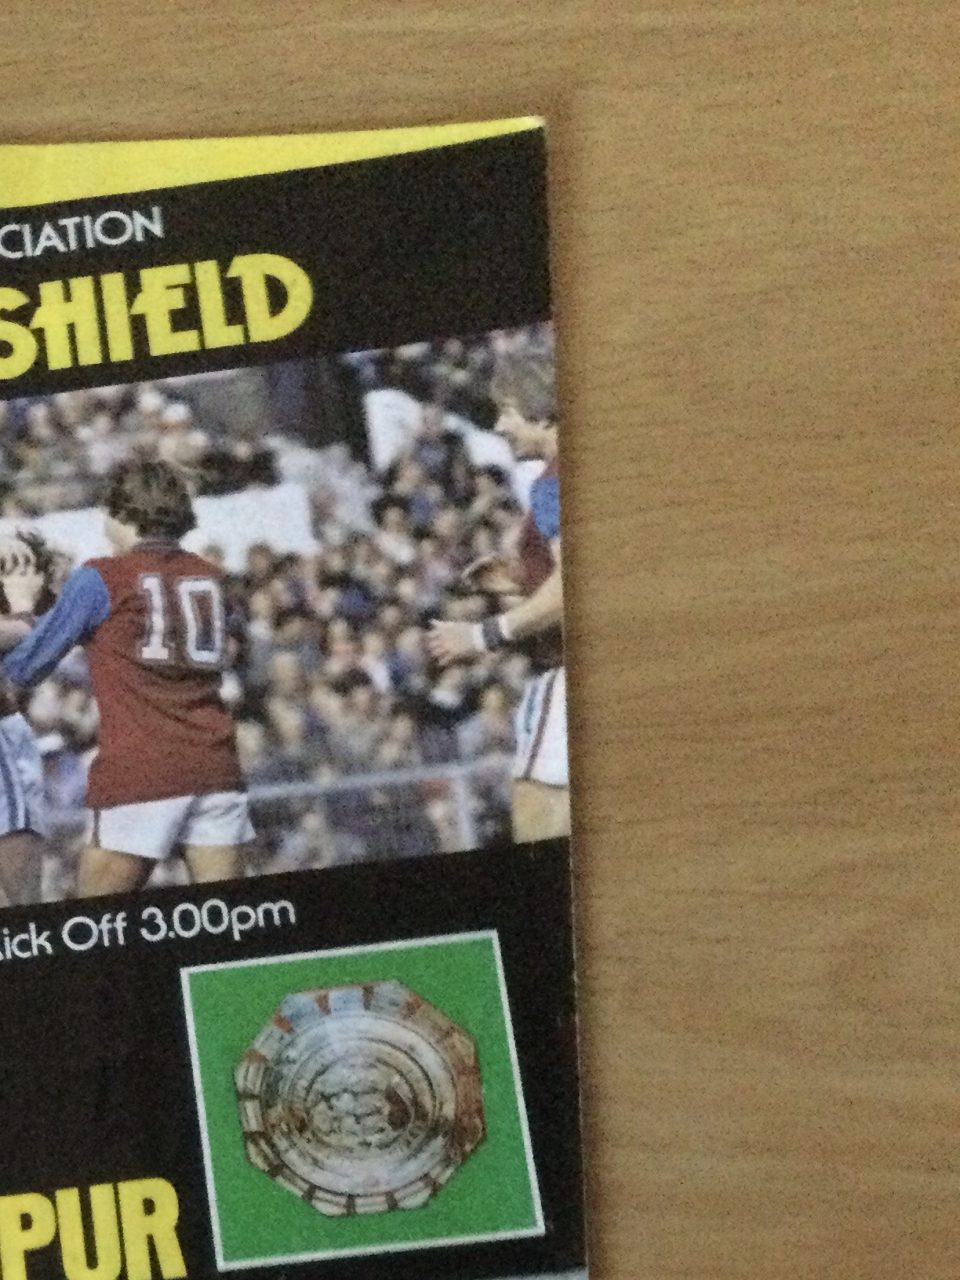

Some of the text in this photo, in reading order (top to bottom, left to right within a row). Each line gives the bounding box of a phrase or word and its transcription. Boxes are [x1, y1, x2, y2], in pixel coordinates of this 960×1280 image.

[139, 573, 224, 666] 10
[61, 911, 128, 951] Off
[139, 898, 297, 942] 3.00pm
